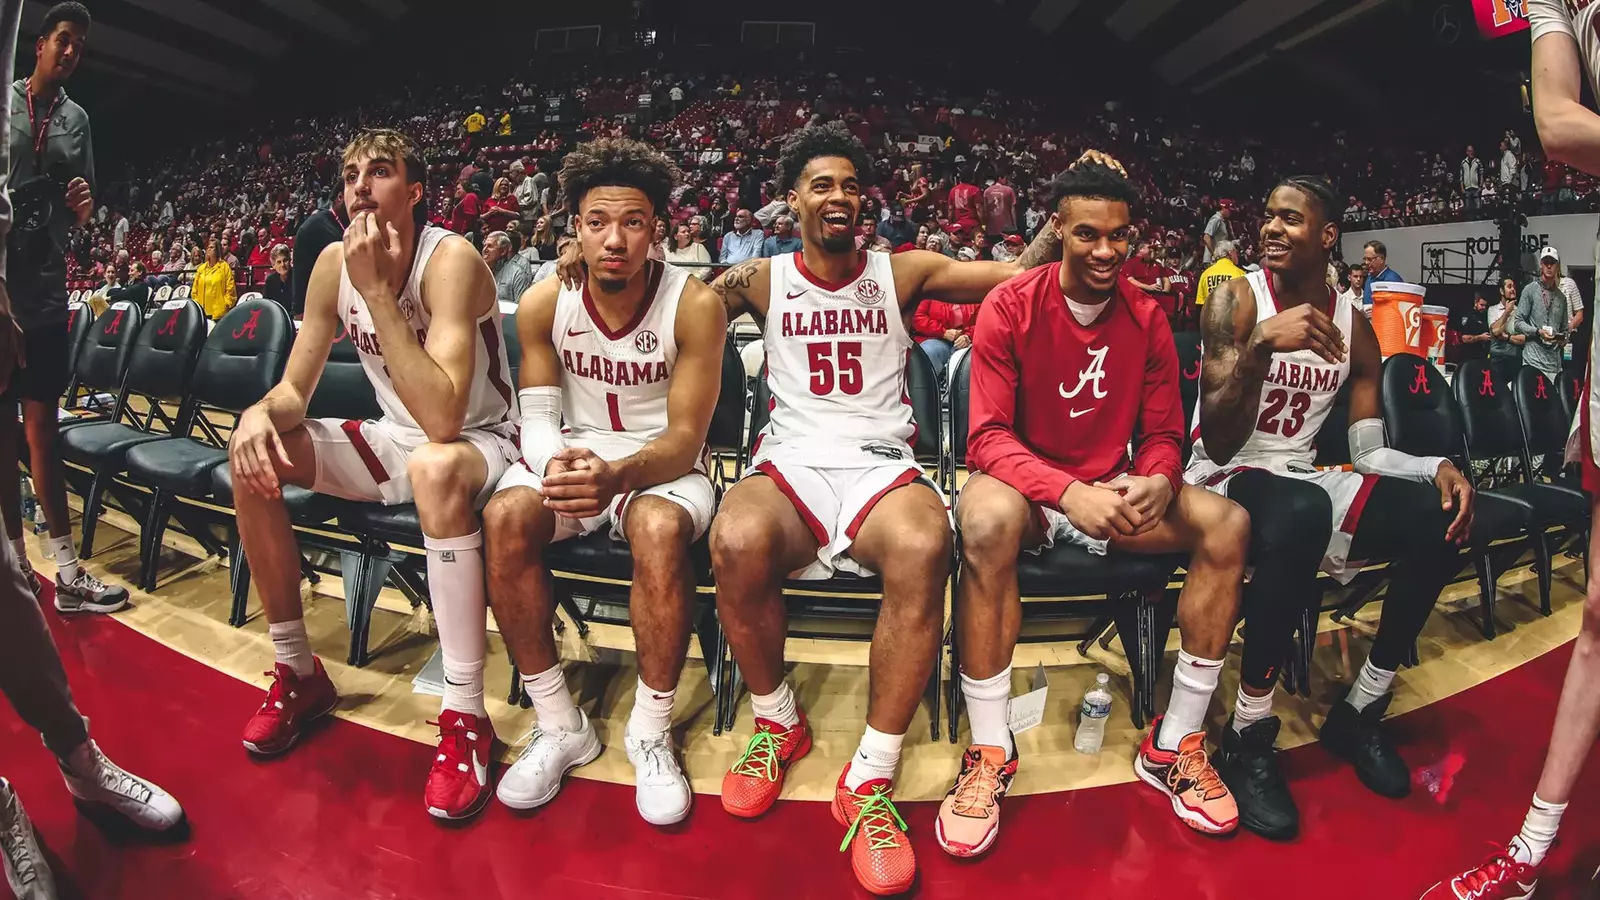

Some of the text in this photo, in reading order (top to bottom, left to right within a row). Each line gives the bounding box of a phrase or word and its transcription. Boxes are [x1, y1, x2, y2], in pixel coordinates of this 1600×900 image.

[1466, 237, 1500, 255] ROL
[858, 279, 879, 298] SEC
[232, 310, 262, 339] A
[782, 309, 888, 337] ALABAMA
[636, 331, 657, 353] SEC
[563, 349, 669, 386] ALABAMA
[807, 341, 863, 396] 55
[1059, 345, 1109, 399] A
[1264, 360, 1340, 391] ABAMA
[1409, 364, 1431, 395] A
[1479, 369, 1495, 396] A
[1534, 375, 1548, 399] A
[606, 392, 627, 432] 1
[1256, 388, 1311, 438] 23
